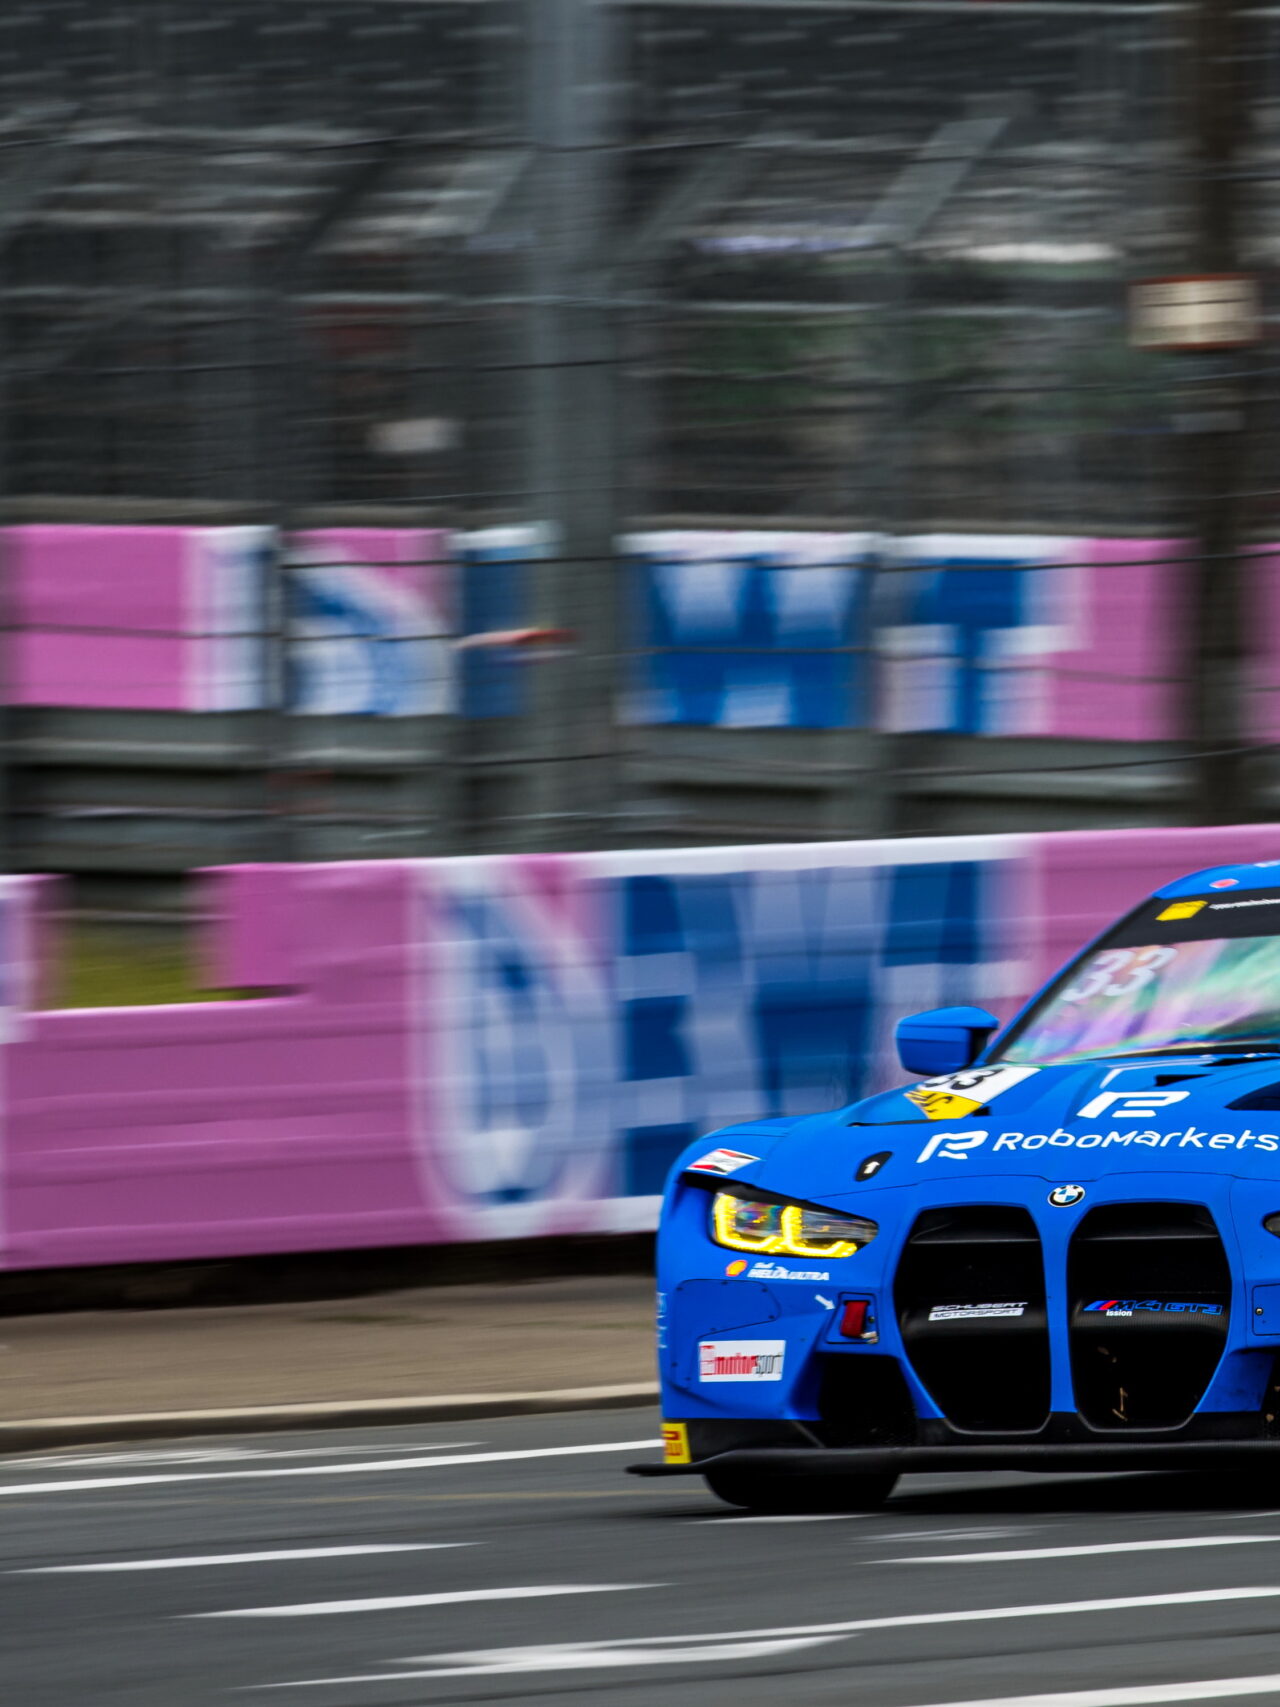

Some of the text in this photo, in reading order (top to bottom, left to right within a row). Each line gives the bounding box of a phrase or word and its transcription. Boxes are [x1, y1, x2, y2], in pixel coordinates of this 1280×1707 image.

[1060, 947, 1178, 1001] 33
[992, 1128, 1280, 1152] RoboMarkets
[931, 1302, 1028, 1312] SCHUBERT
[1164, 1302, 1223, 1315] GT3
